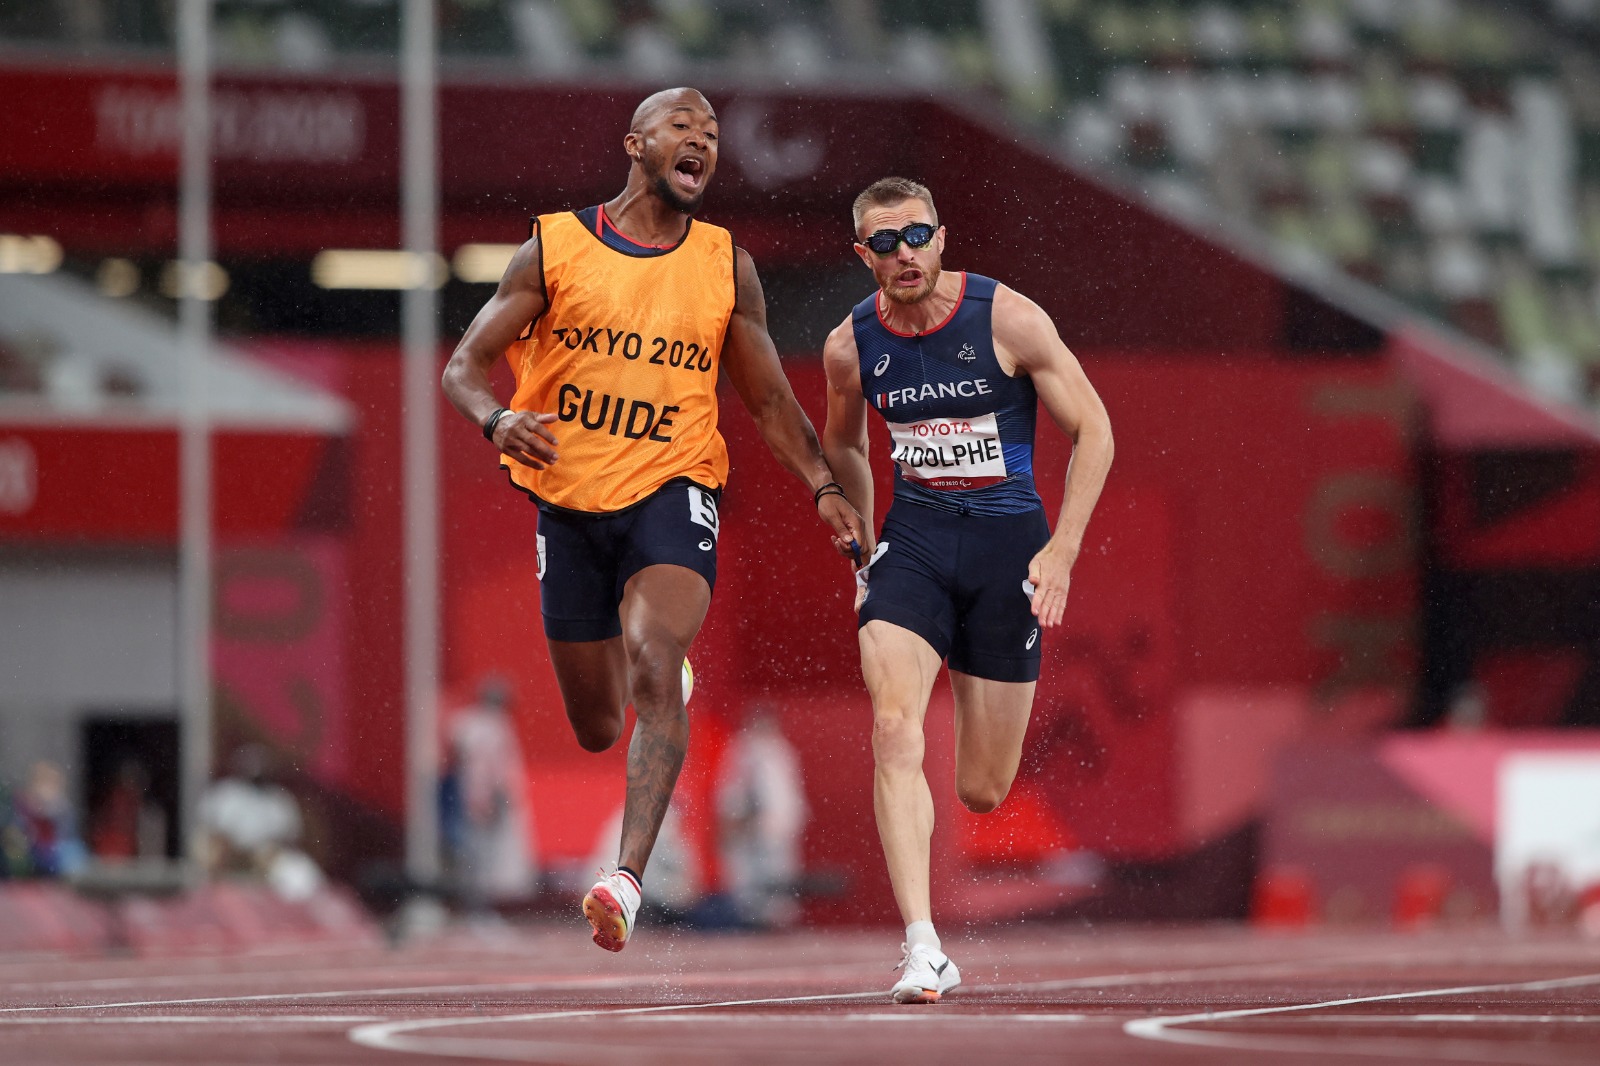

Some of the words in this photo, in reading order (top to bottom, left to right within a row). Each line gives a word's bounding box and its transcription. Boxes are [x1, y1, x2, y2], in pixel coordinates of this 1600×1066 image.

[552, 327, 643, 361] TOKYO
[649, 336, 712, 373] 2020
[889, 379, 993, 408] FRANCE
[558, 383, 680, 443] GUIDE
[909, 421, 973, 437] TOYOTA
[896, 437, 1000, 468] ADOLPHE
